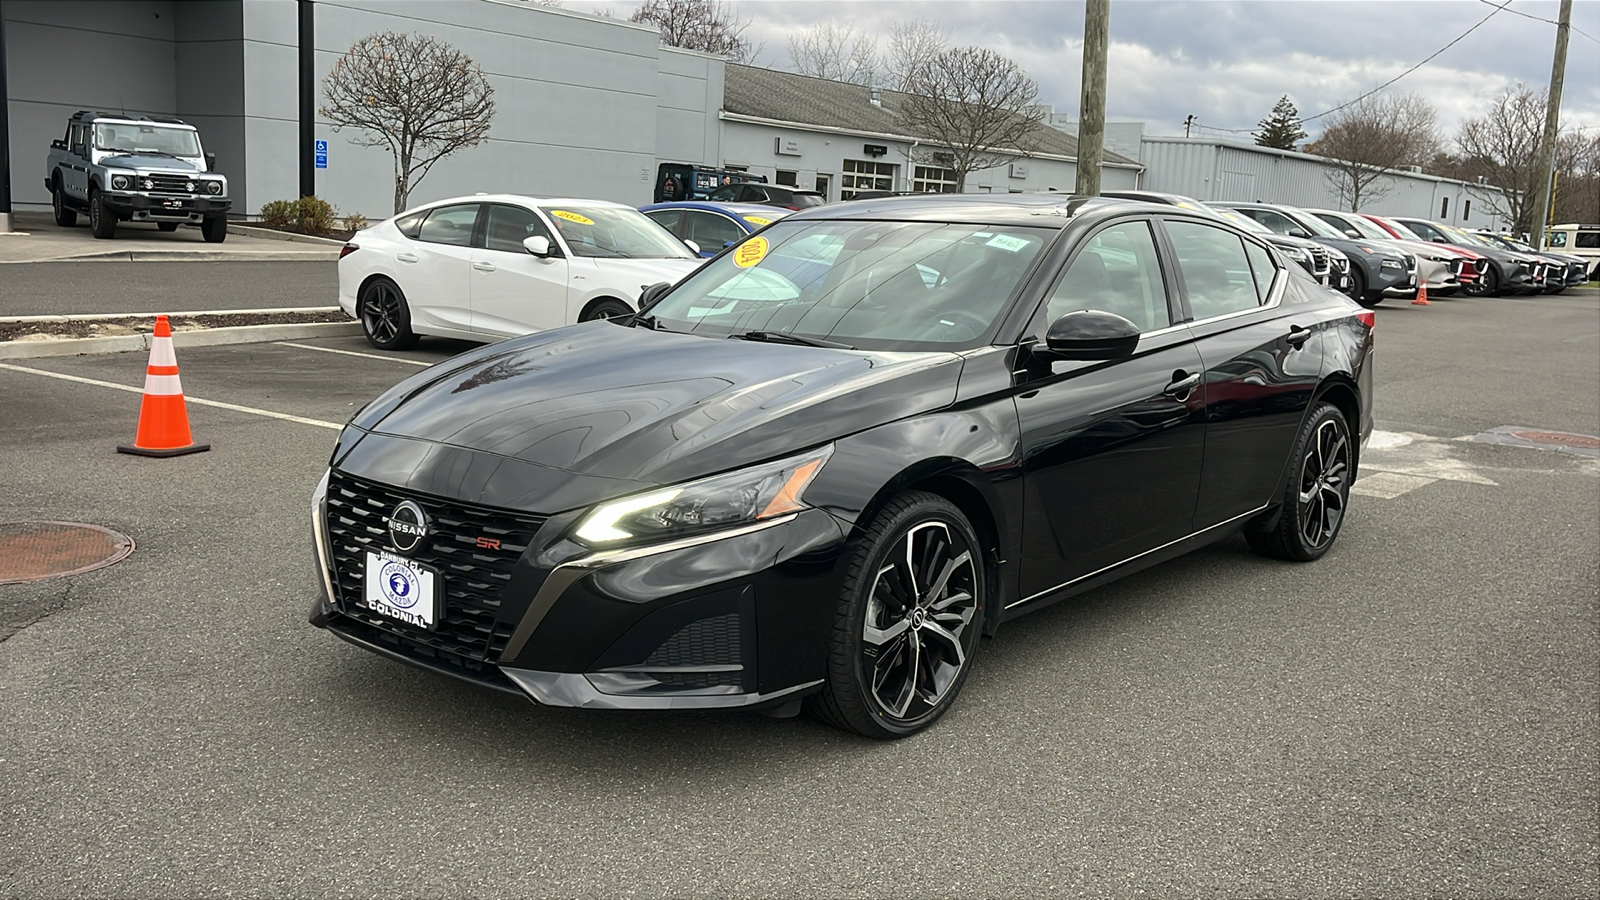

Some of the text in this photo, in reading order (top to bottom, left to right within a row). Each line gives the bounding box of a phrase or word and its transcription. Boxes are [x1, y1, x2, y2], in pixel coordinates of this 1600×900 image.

[741, 241, 761, 263] 2024
[388, 519, 426, 537] NISSAN
[476, 536, 501, 550] SR
[384, 564, 415, 586] COLONIAL
[388, 590, 412, 605] MAZDA
[368, 600, 428, 629] COLONIAL
